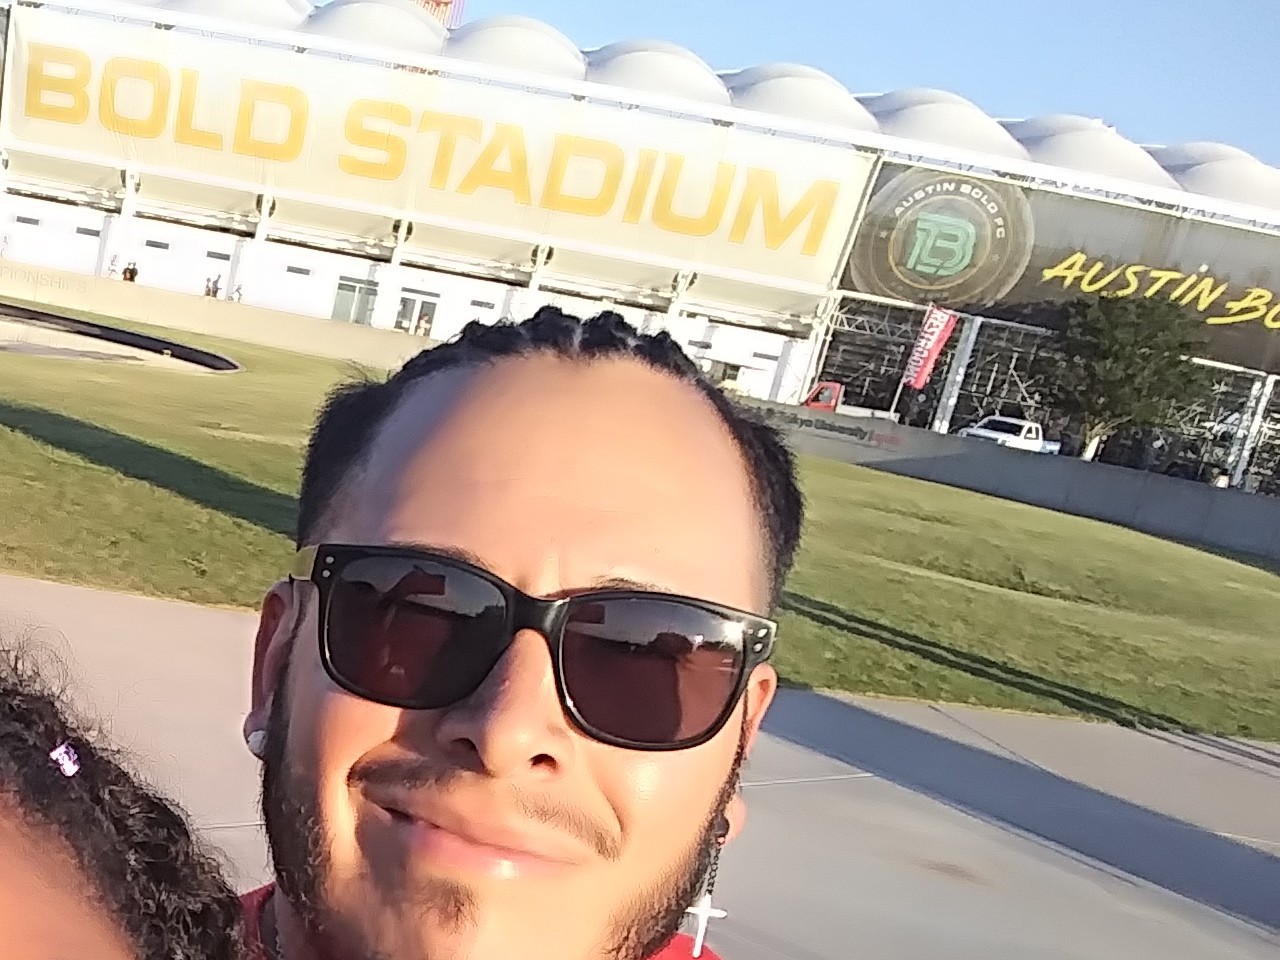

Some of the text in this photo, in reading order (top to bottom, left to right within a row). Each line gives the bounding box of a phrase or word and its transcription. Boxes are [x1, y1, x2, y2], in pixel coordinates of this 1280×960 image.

[25, 41, 841, 257] BOLD STADIUM
[894, 182, 1006, 238] AUSTIN BOLD FC
[1040, 251, 1230, 312] AUSTIN
